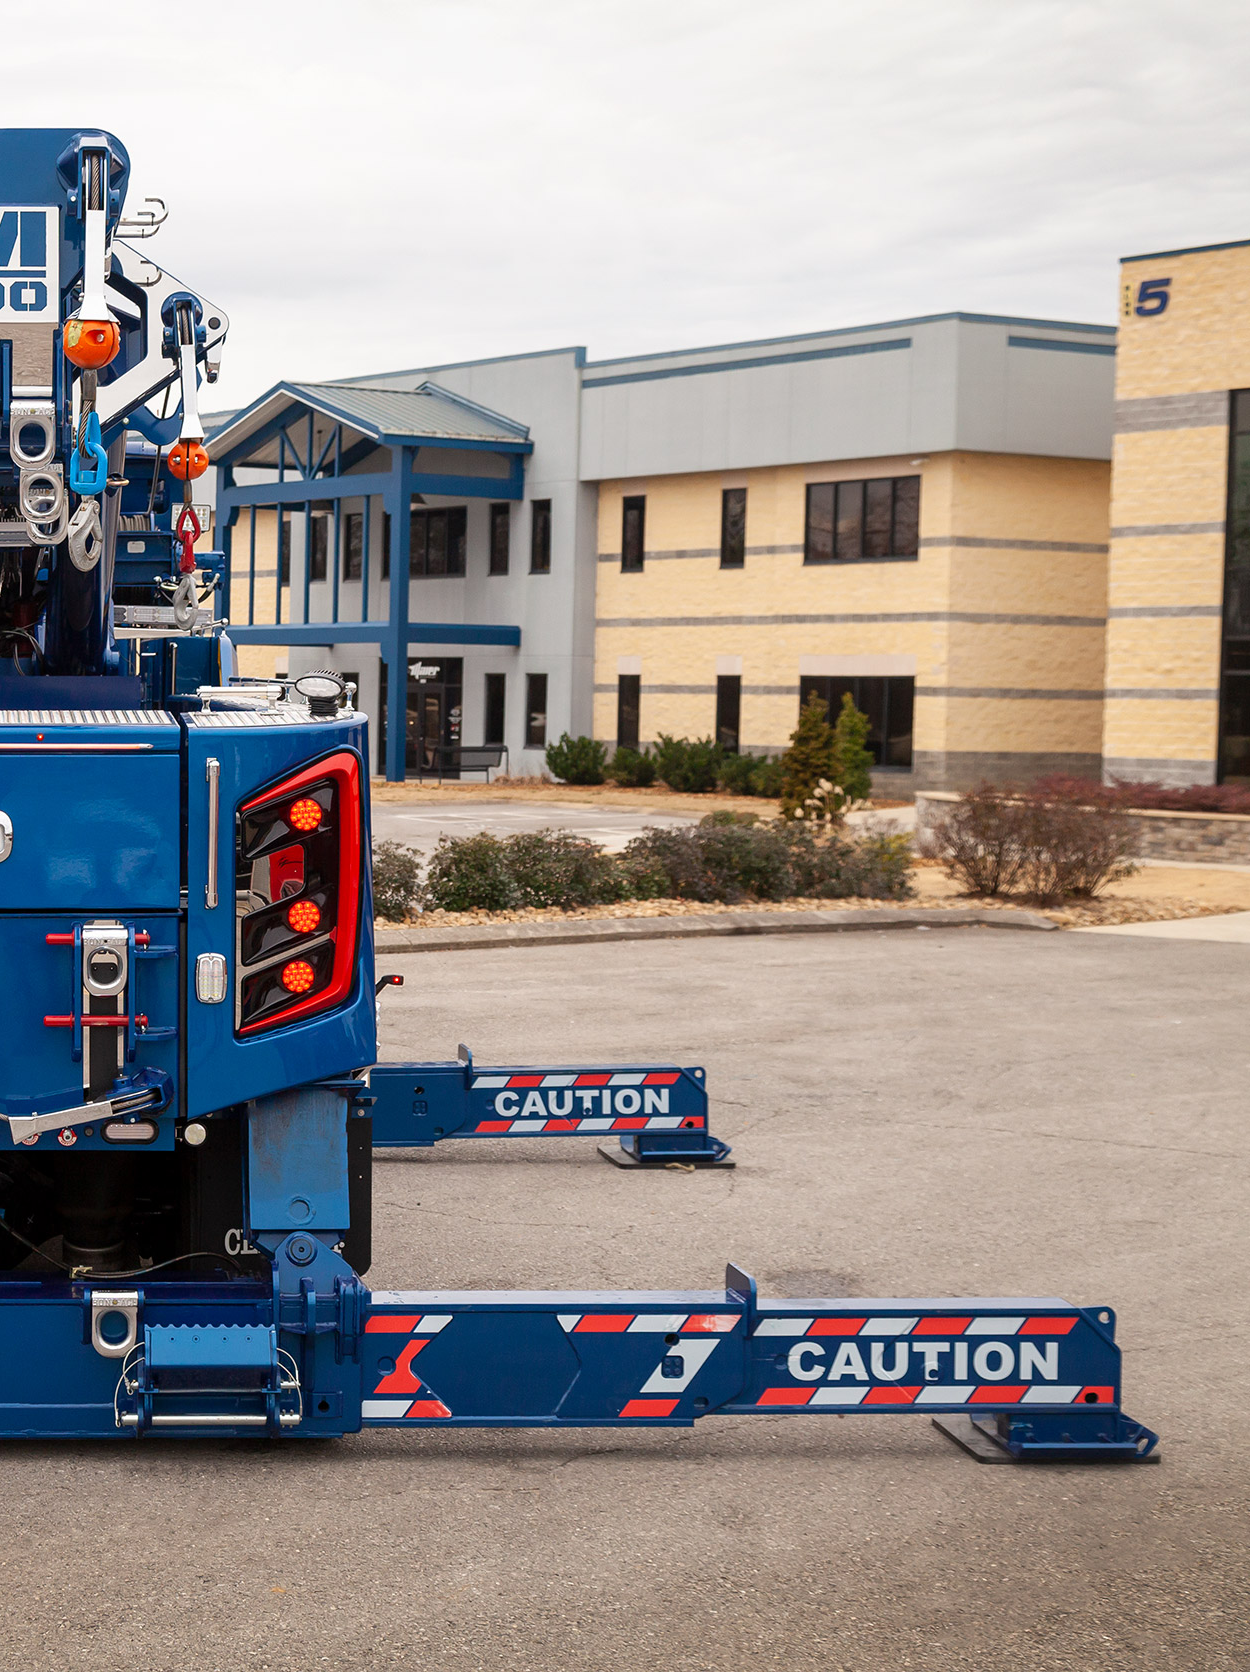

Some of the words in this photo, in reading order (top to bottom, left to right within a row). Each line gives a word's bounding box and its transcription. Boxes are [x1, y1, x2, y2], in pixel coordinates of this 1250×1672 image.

[1136, 278, 1172, 317] 5
[495, 1089, 669, 1117] CAUTION
[787, 1342, 1059, 1381] CAUTION
